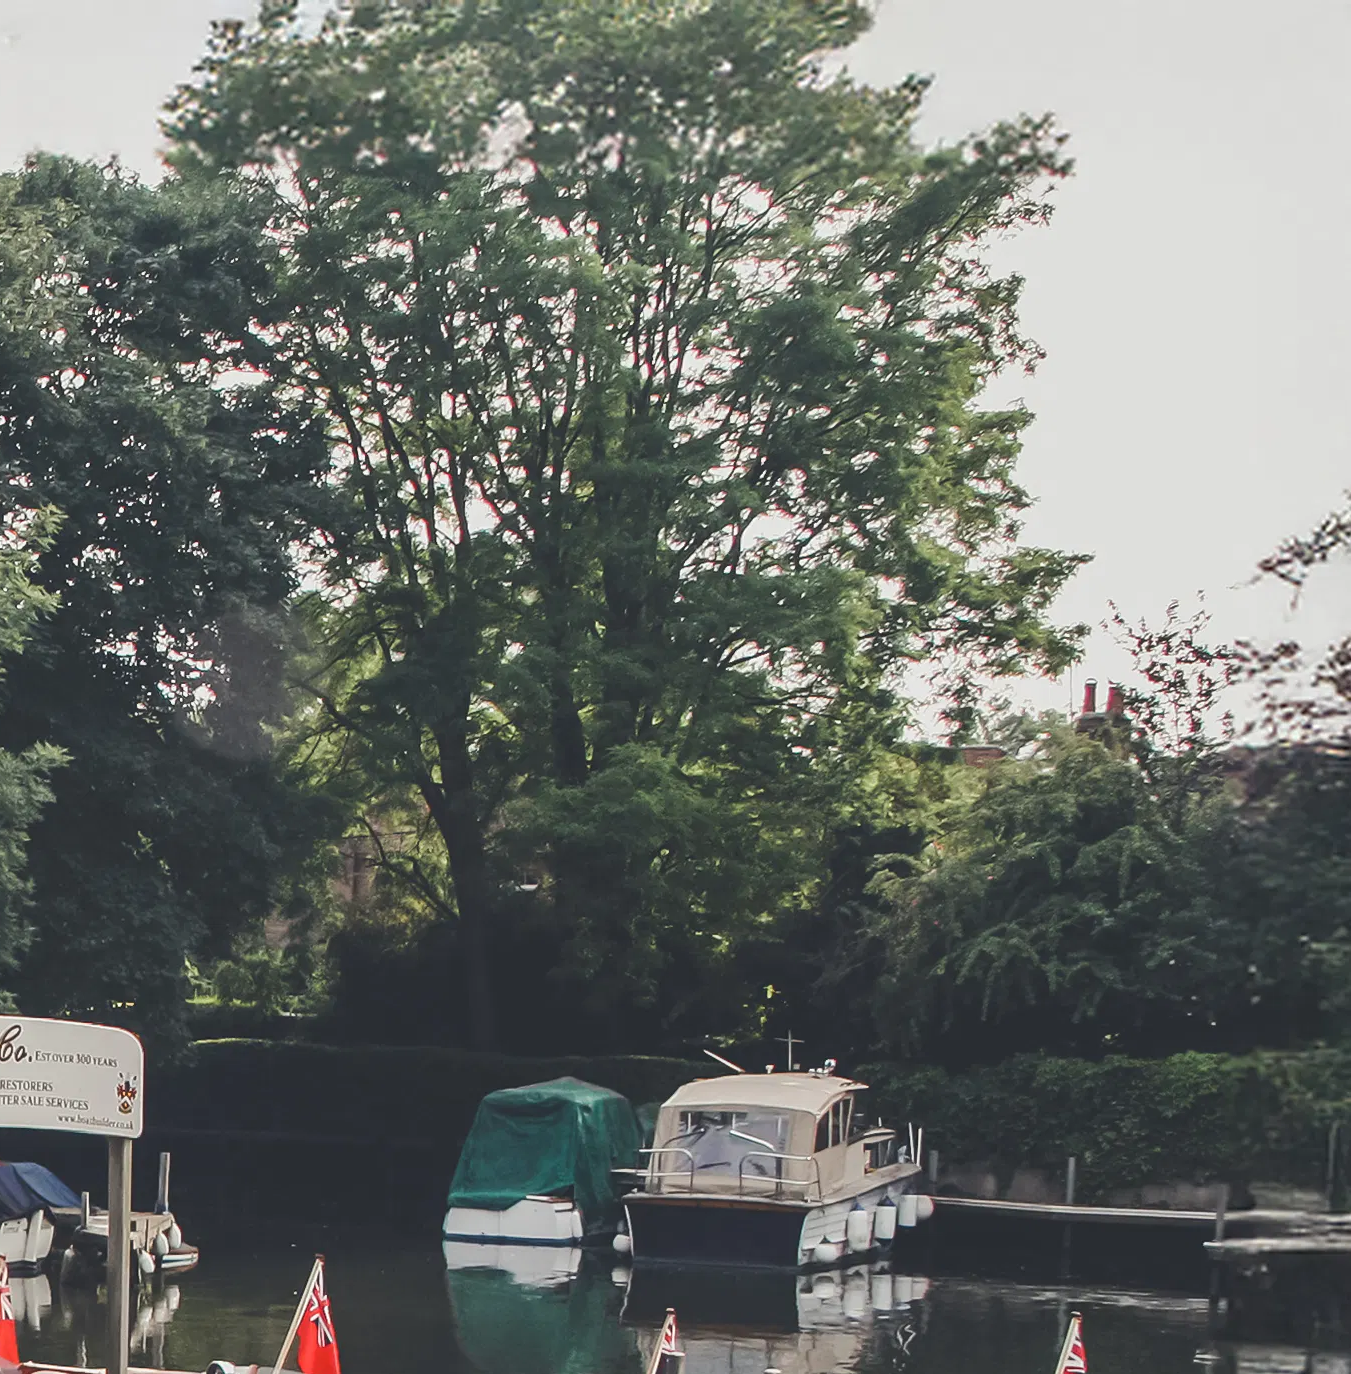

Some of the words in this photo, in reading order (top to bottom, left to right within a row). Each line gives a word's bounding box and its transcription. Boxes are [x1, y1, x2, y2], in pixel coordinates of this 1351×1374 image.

[52, 1052, 75, 1063] OVER
[76, 1053, 91, 1065] 300
[93, 1057, 118, 1068] YEARS
[0, 1080, 54, 1092] RESTORERS
[21, 1095, 44, 1107] SALE
[45, 1096, 89, 1110] SERVICES
